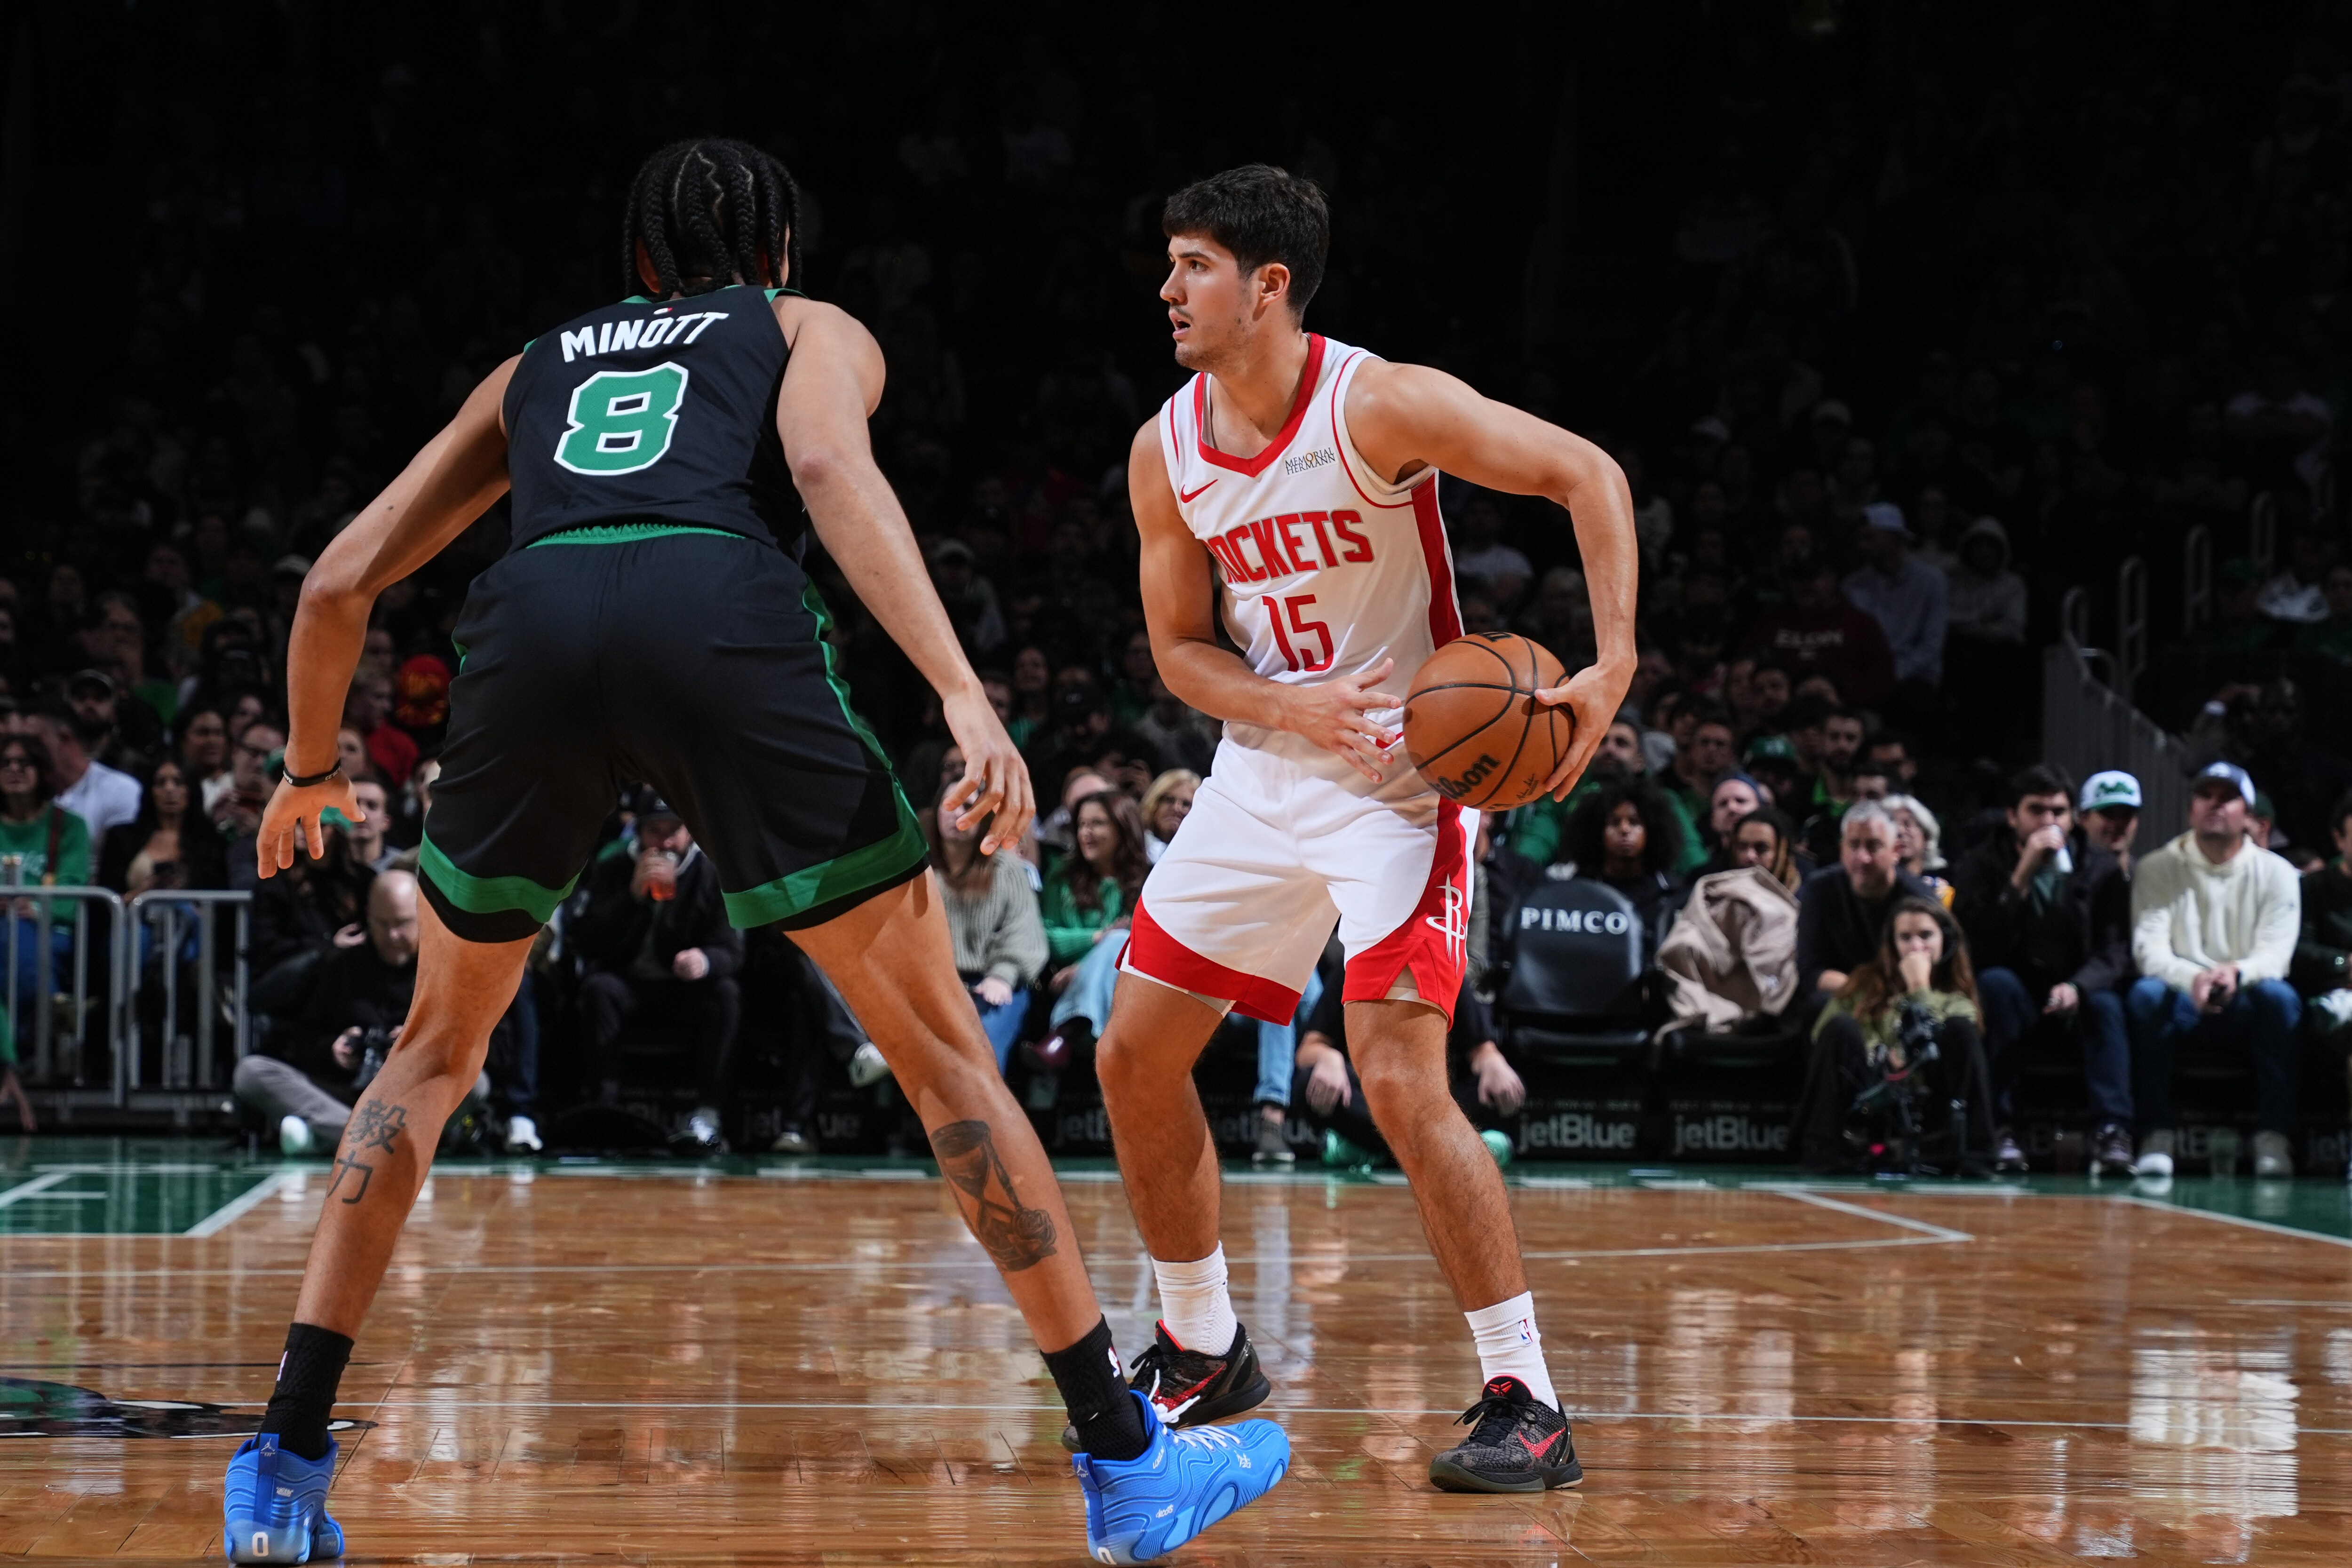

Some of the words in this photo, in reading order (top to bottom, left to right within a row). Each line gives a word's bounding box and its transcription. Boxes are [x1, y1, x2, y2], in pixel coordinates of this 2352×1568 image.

[560, 311, 729, 363] MINOTT
[553, 361, 689, 476] 8
[1285, 447, 1334, 468] MEMORIAL
[1286, 454, 1335, 475] HERMANN
[1200, 509, 1375, 584] OCKETS
[1261, 594, 1334, 672] 15
[1520, 907, 1629, 935] PIMCO
[1517, 1112, 1637, 1154] jetBlue
[1672, 1114, 1789, 1156] jetBlue
